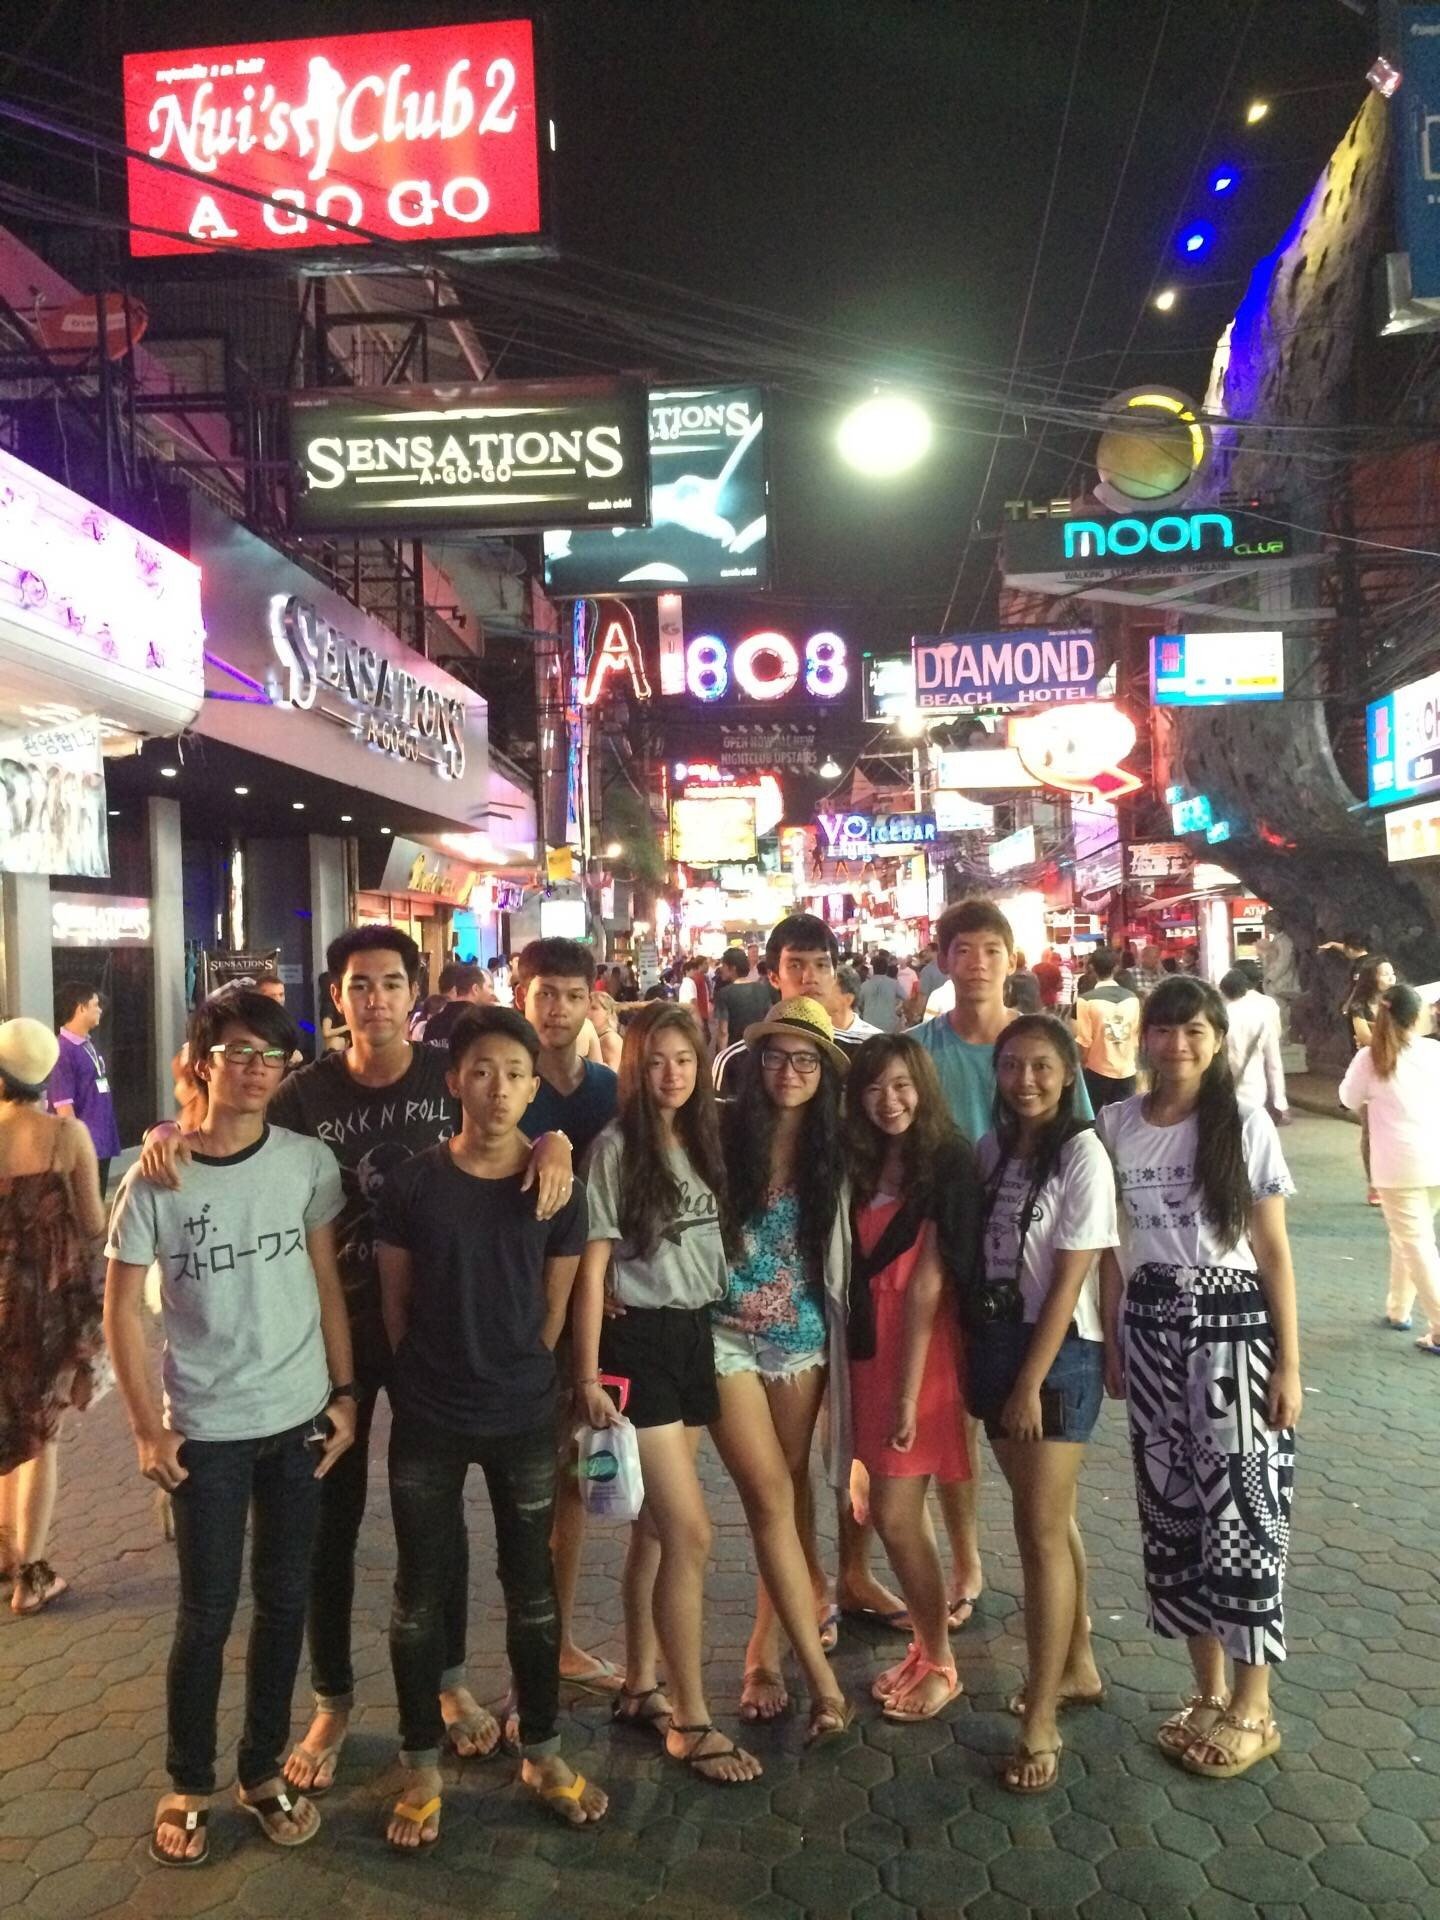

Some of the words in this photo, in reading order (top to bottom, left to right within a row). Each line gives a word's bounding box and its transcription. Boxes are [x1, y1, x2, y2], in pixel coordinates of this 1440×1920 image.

[149, 83, 292, 173] Nui's
[338, 59, 475, 153] Club
[479, 58, 517, 135] 2
[188, 195, 238, 239] A
[263, 185, 364, 236] GO
[388, 177, 490, 227] GO
[307, 425, 624, 489] SENSATIONS
[917, 639, 1096, 689] DIAMOND
[919, 691, 993, 707] BEACH
[1018, 687, 1095, 703] HOTEL
[1243, 905, 1266, 916] ATM
[210, 959, 273, 971] SENSATIONS
[317, 1107, 371, 1144] ROCK
[381, 1103, 395, 1129] N
[405, 1097, 451, 1125] ROLL
